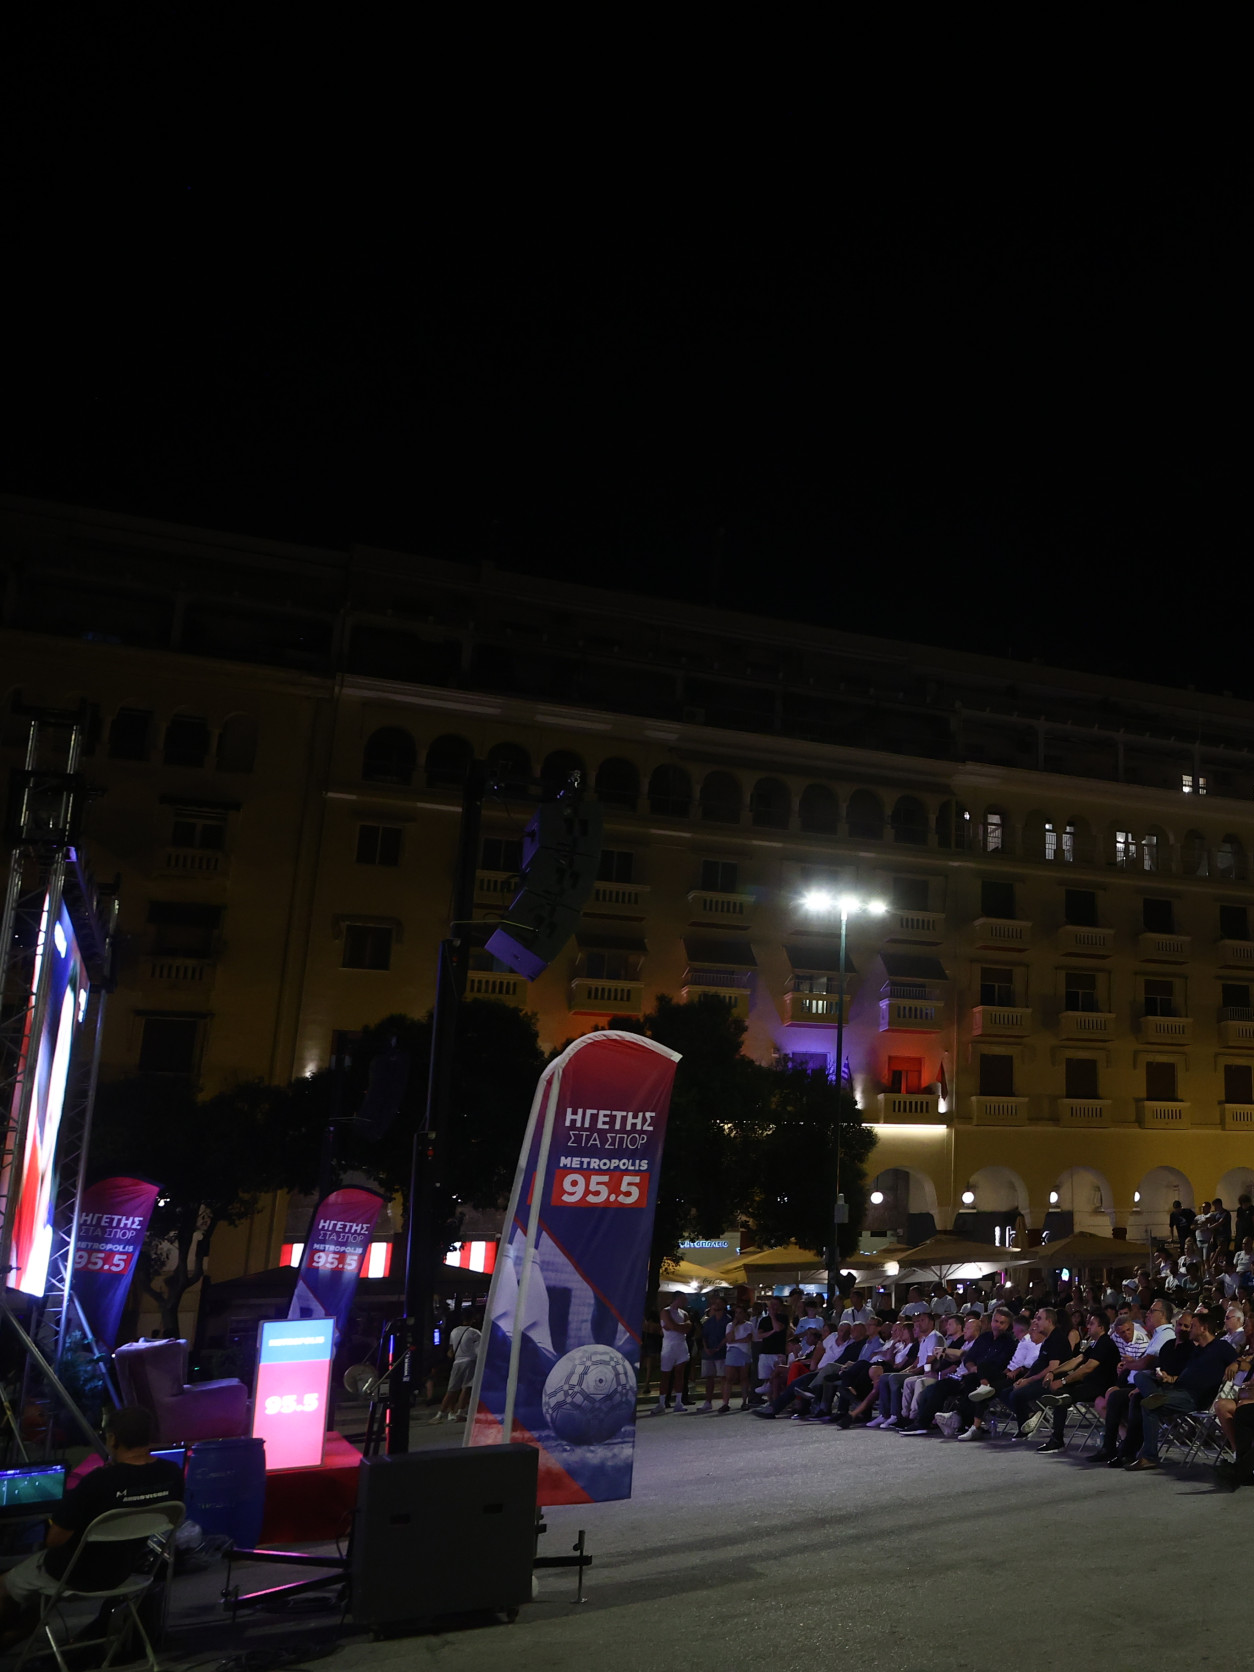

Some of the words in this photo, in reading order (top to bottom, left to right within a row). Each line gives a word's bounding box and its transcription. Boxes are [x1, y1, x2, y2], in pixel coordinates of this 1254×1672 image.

[565, 1107, 656, 1131] ΗΓΕΤΗΣ
[567, 1130, 600, 1148] ΣΤΑ
[604, 1133, 648, 1149] ΣΠΟΡ
[559, 1155, 649, 1171] METROPOLIS
[561, 1173, 641, 1205] 95.5
[80, 1212, 143, 1229] ΗΓΕΤΗΣ
[318, 1219, 370, 1234] ΗΓΕΤΗΣ
[80, 1225, 102, 1237] ΣΤΑ
[104, 1228, 136, 1240] ΣΠΟΡ
[318, 1230, 337, 1241] ΣΤΑ
[338, 1232, 364, 1243] ΣΠΟΡ
[312, 1243, 364, 1254] METROPOLIS
[74, 1251, 128, 1271] 95.5
[312, 1252, 358, 1270] 95.5
[264, 1392, 319, 1415] 95.5
